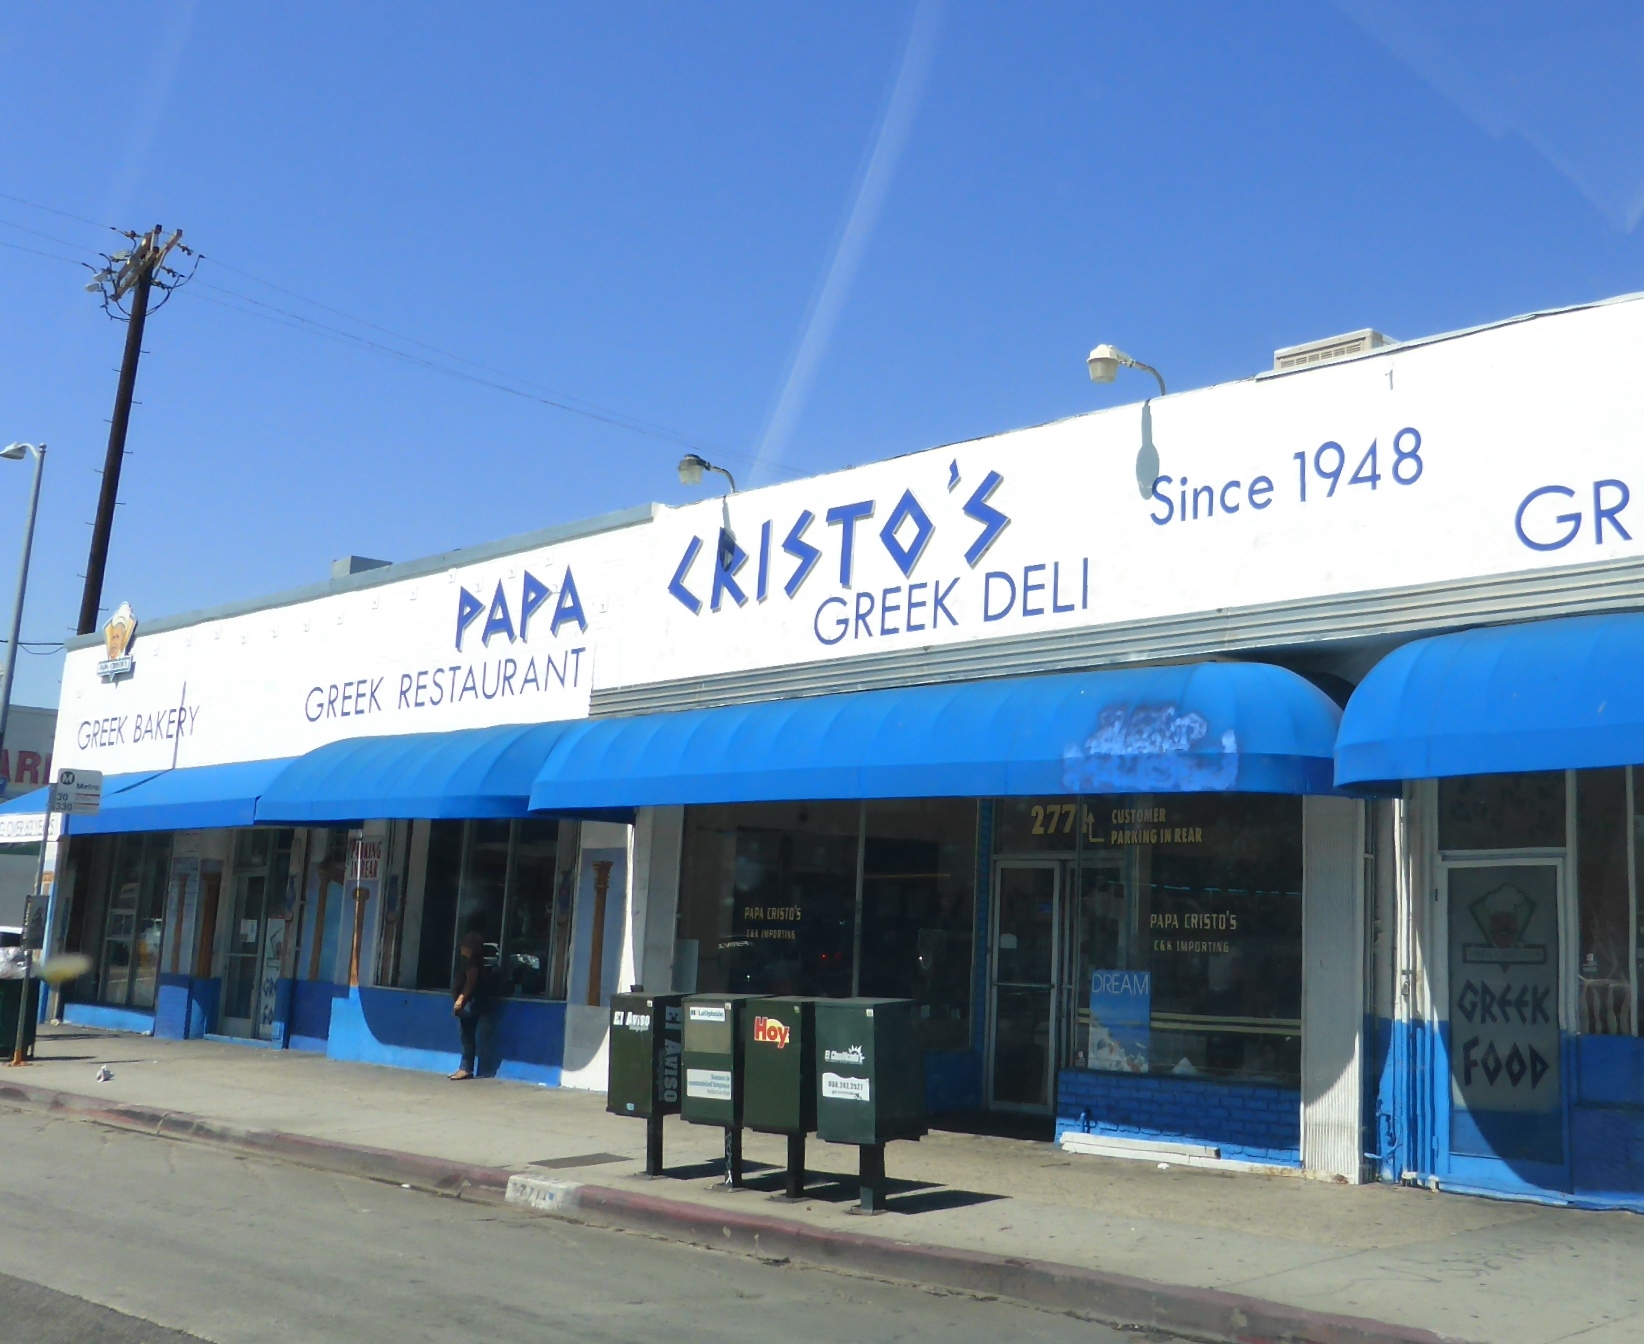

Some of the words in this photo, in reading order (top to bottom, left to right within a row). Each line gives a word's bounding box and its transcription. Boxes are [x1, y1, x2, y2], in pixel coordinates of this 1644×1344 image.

[1150, 474, 1274, 526] Since
[1292, 427, 1424, 503] 1948
[1514, 479, 1633, 552] GR
[668, 458, 1011, 616] CRISTO'S
[455, 564, 588, 653] PAPA
[814, 576, 960, 646] GREEK
[983, 557, 1089, 622] DELI
[304, 676, 385, 722] GREEK
[397, 646, 587, 711] RESTAURANT
[78, 715, 128, 750] GREEK
[133, 705, 200, 743] BAKERY
[76, 782, 100, 790] Metro
[1111, 807, 1167, 824] CUSTOMER
[1110, 829, 1157, 845] PARKING
[1160, 828, 1172, 844] IN
[1174, 826, 1203, 844] REAR
[744, 906, 764, 920] PAPA
[766, 904, 802, 921] CRISTO'S
[1149, 914, 1179, 929] PAPA
[1184, 910, 1238, 931] CRISTO'S
[761, 929, 796, 940] IMPORTING
[1153, 940, 1173, 953] C&K
[1176, 940, 1230, 954] IMPORTING
[1091, 973, 1150, 996] DREAM
[613, 1011, 625, 1026] El
[1456, 979, 1551, 1025] GREEK
[754, 1016, 790, 1049] Hoy
[1462, 1036, 1550, 1089] FOOD
